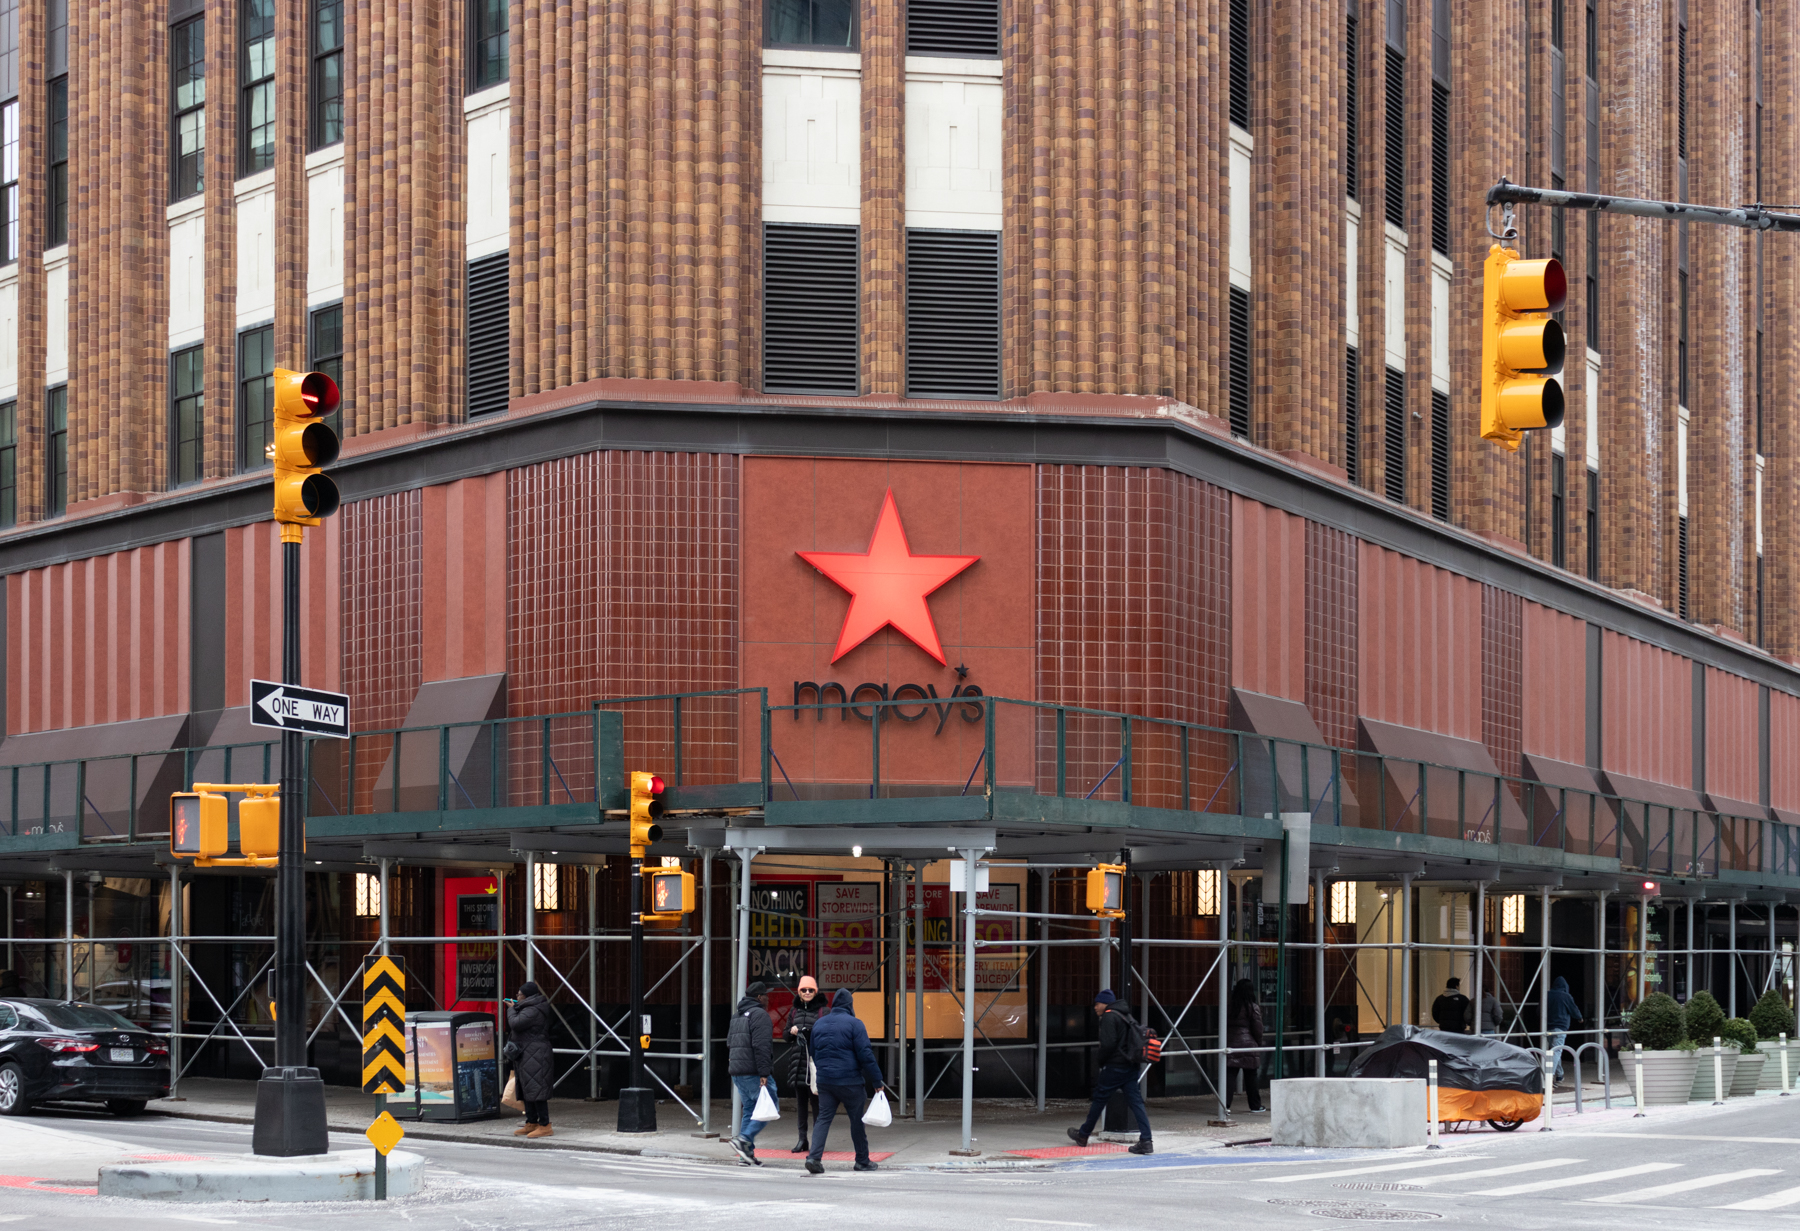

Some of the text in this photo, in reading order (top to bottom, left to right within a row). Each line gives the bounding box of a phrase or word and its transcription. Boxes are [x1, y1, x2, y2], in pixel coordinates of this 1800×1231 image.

[793, 663, 984, 735] macy's
[272, 697, 339, 723] ONE WAY
[835, 887, 860, 899] SAVE
[751, 890, 804, 910] NOTHING
[464, 903, 494, 912] THIS STORE
[821, 902, 874, 914] STOREWIDE
[470, 914, 487, 923] ONLY
[751, 912, 805, 947] HELD
[825, 921, 872, 950] 50%
[461, 932, 496, 957] TOTAL
[461, 963, 496, 974] INVENTORY
[751, 948, 805, 977] BACK!
[822, 960, 875, 971] EVERY ITEM
[992, 961, 1014, 971] ITEM
[824, 973, 872, 984] REDUCED!
